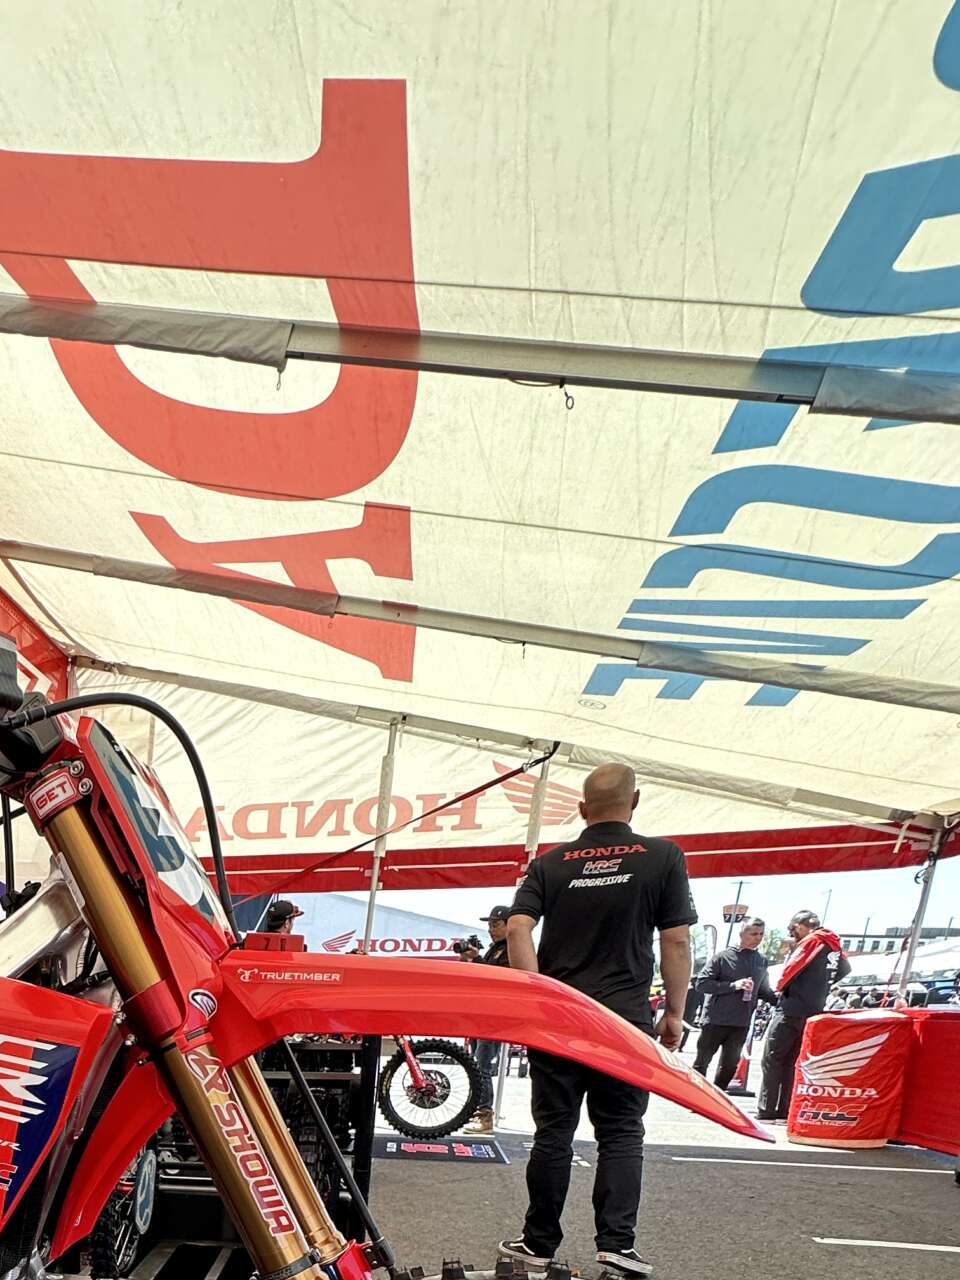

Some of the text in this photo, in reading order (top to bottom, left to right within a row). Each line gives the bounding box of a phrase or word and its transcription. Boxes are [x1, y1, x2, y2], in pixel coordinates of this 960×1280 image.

[562, 843, 648, 861] HONDA
[582, 858, 622, 875] HRC
[567, 873, 634, 889] PROGRESSIVE
[259, 971, 341, 983] TRUETIMBER
[796, 1083, 880, 1098] HONDA
[213, 1101, 296, 1237] SHOWA
